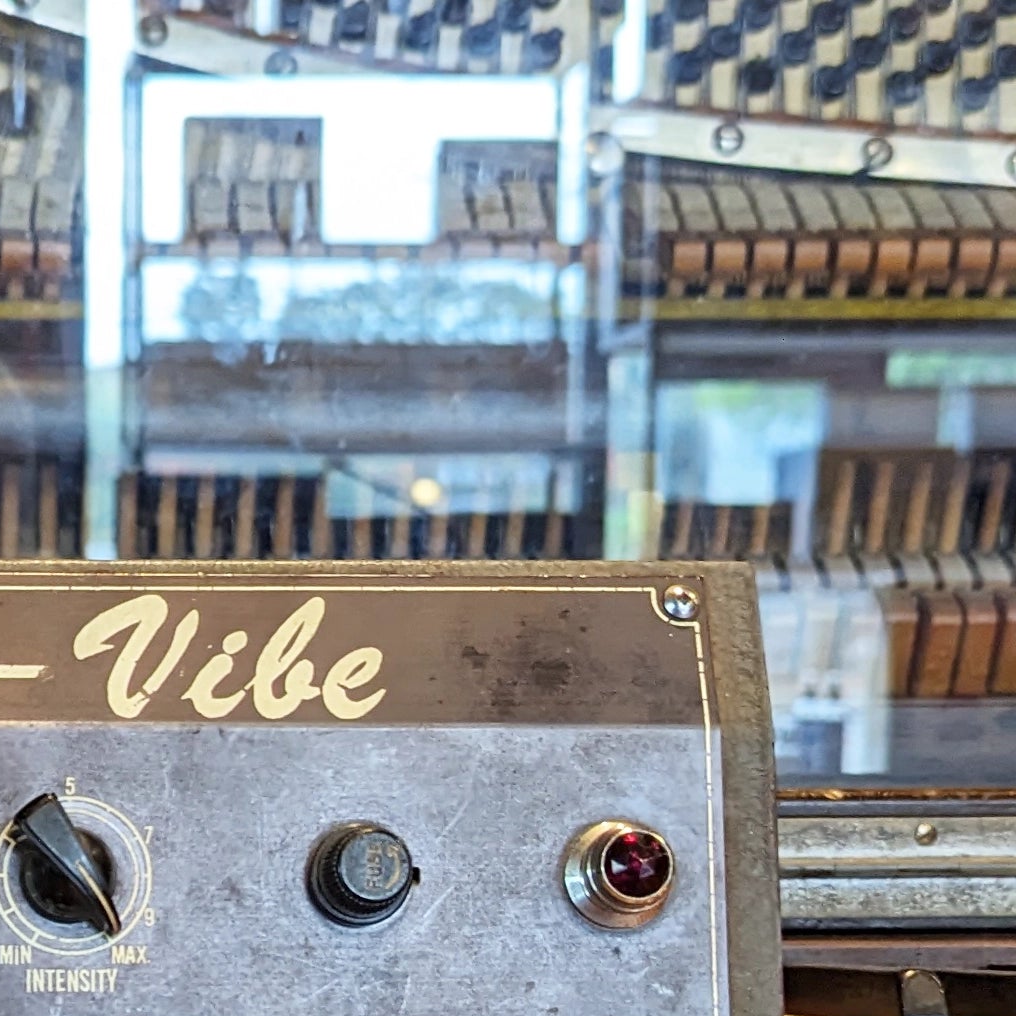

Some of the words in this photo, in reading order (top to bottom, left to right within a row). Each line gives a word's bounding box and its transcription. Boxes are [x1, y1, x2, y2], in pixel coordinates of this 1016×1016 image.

[65, 777, 76, 795] 5
[143, 826, 154, 844] 7
[144, 908, 155, 926] 9
[0, 945, 32, 965] MIN
[26, 968, 118, 993] INTENSITY
